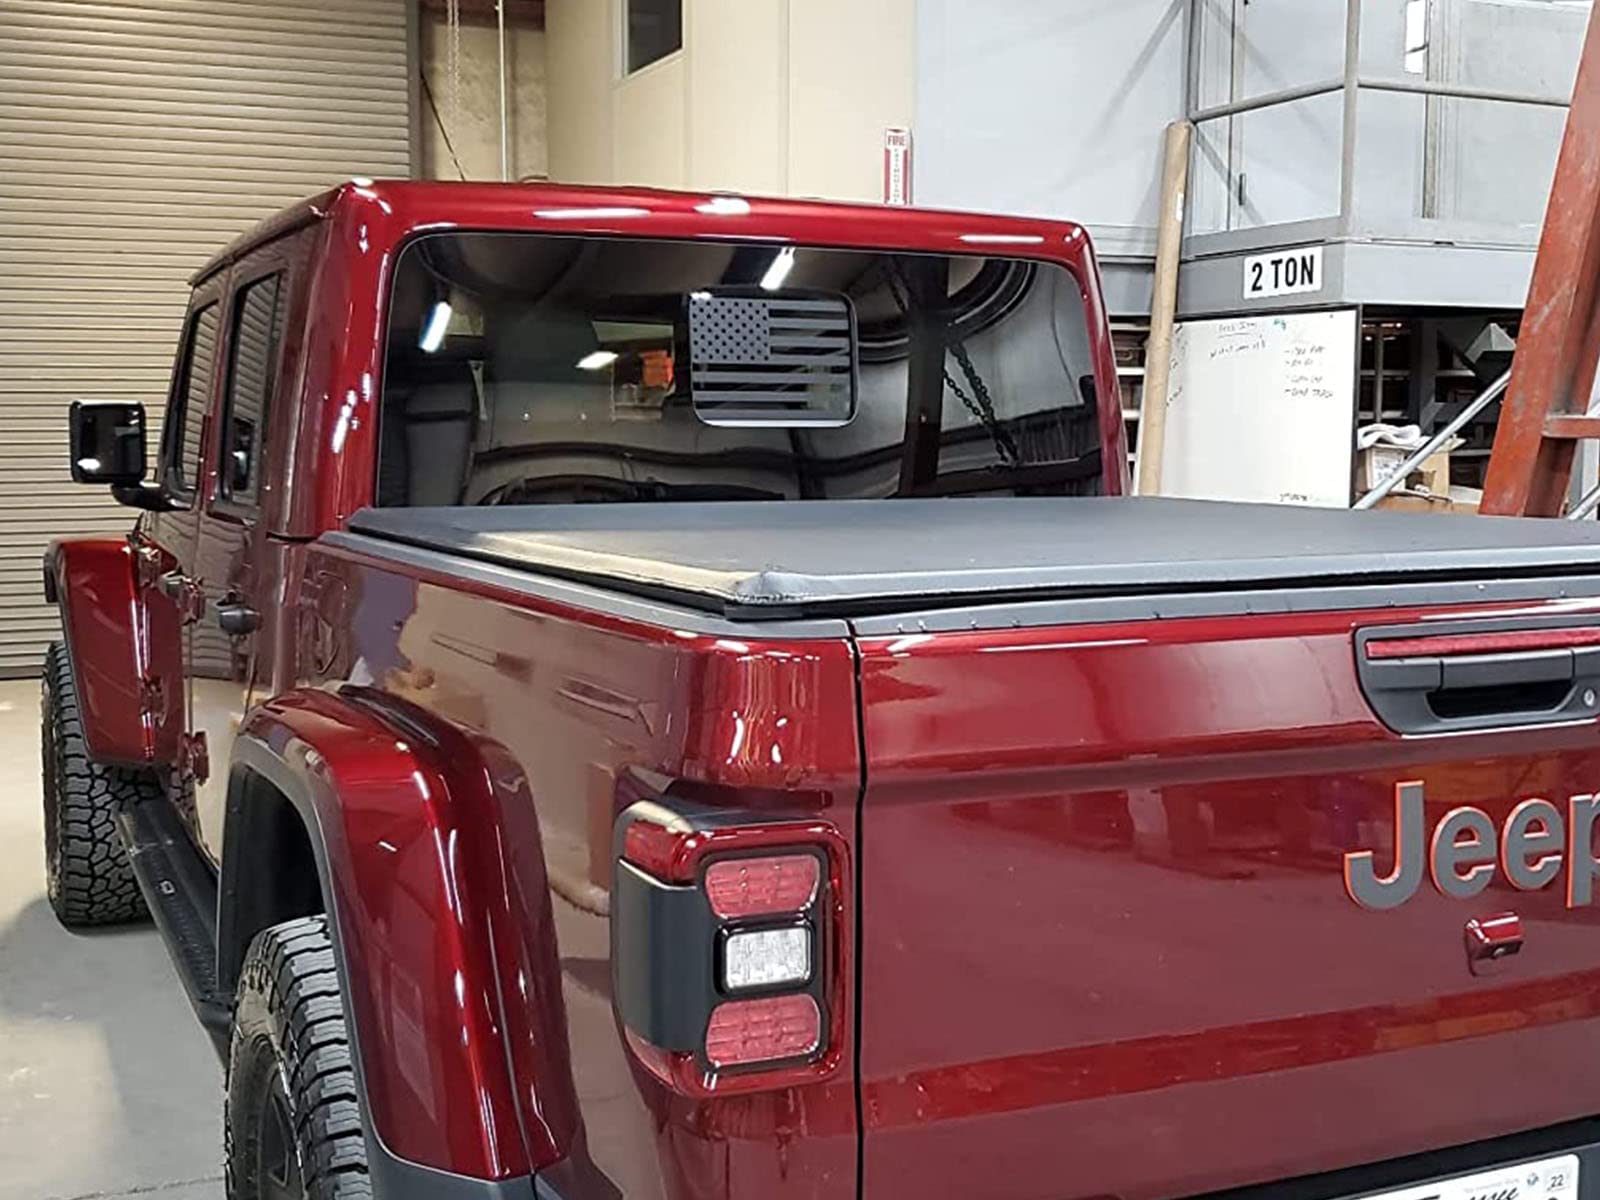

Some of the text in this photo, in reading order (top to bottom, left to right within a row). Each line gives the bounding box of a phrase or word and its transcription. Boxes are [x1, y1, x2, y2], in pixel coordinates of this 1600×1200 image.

[1251, 254, 1314, 292] 2 TON
[1550, 1174, 1564, 1188] 22
